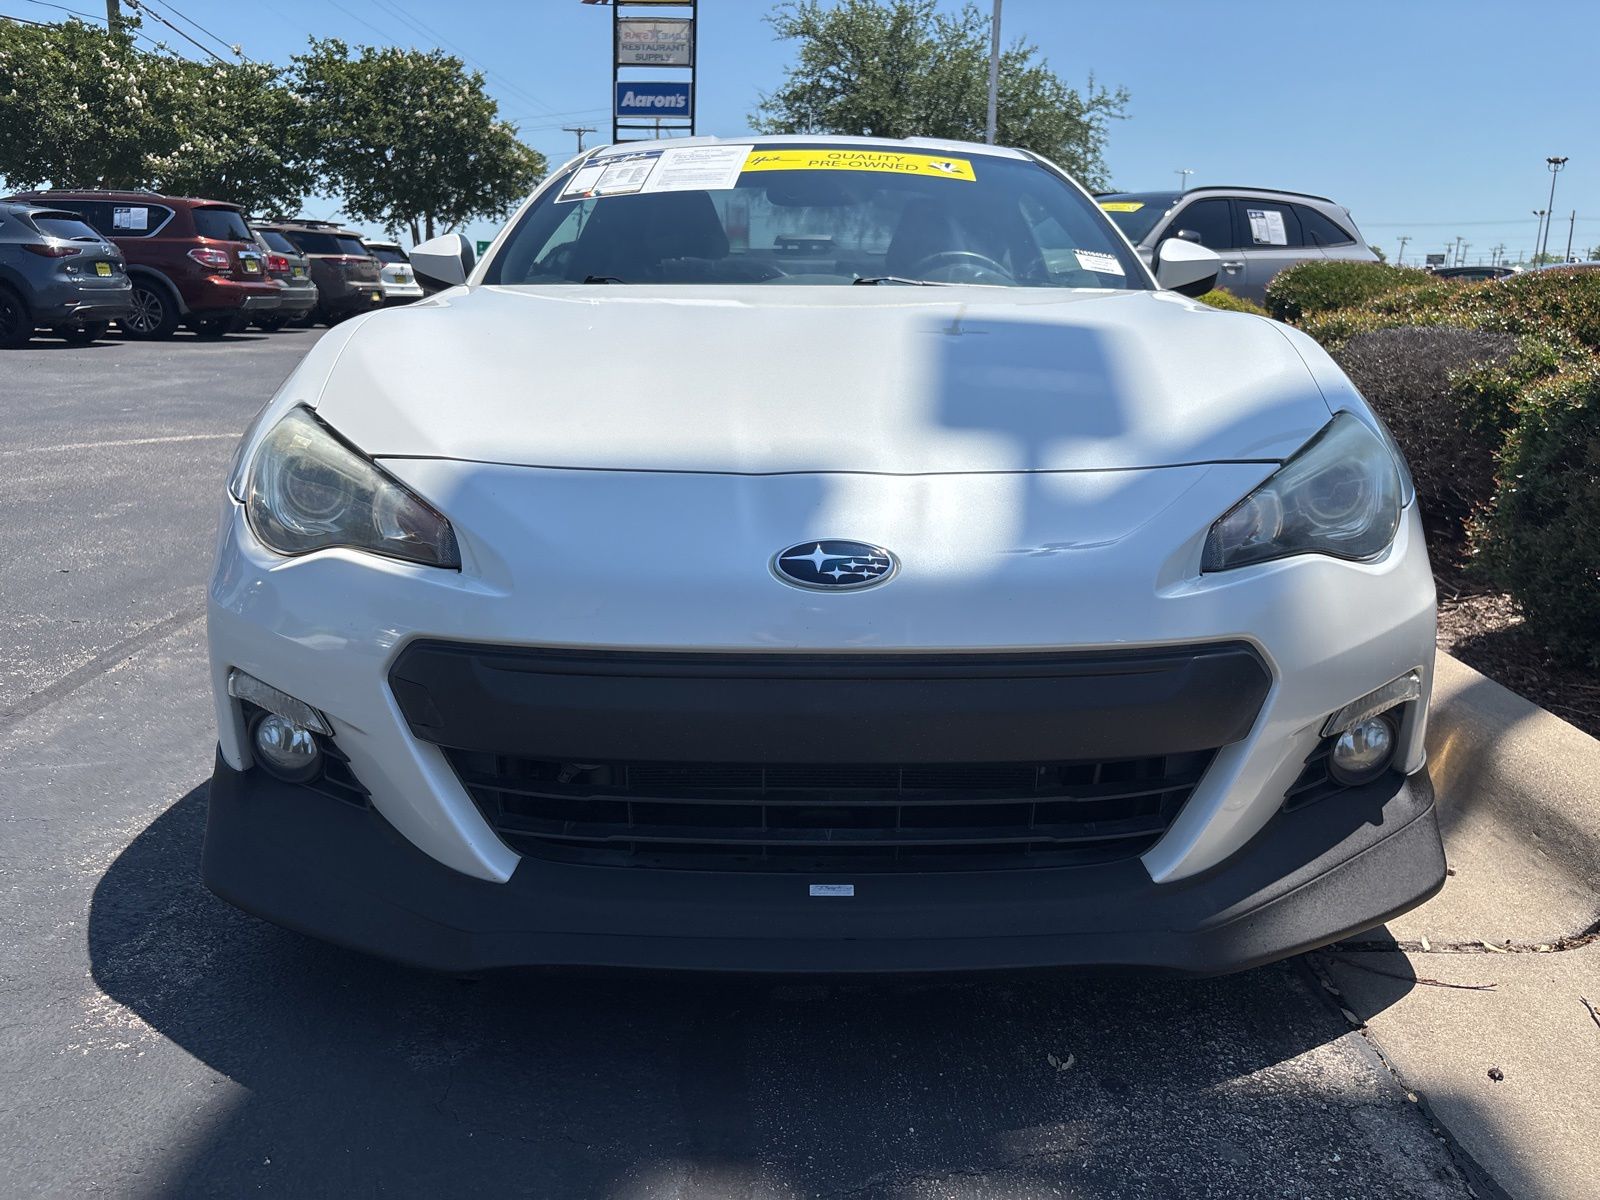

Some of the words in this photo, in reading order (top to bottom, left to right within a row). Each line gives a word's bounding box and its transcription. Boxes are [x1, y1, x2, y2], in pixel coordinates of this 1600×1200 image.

[635, 53, 672, 61] SUPPLY
[621, 91, 686, 108] Aaron's
[827, 153, 905, 162] QUALITY
[808, 160, 919, 171] PRE-OWNED
